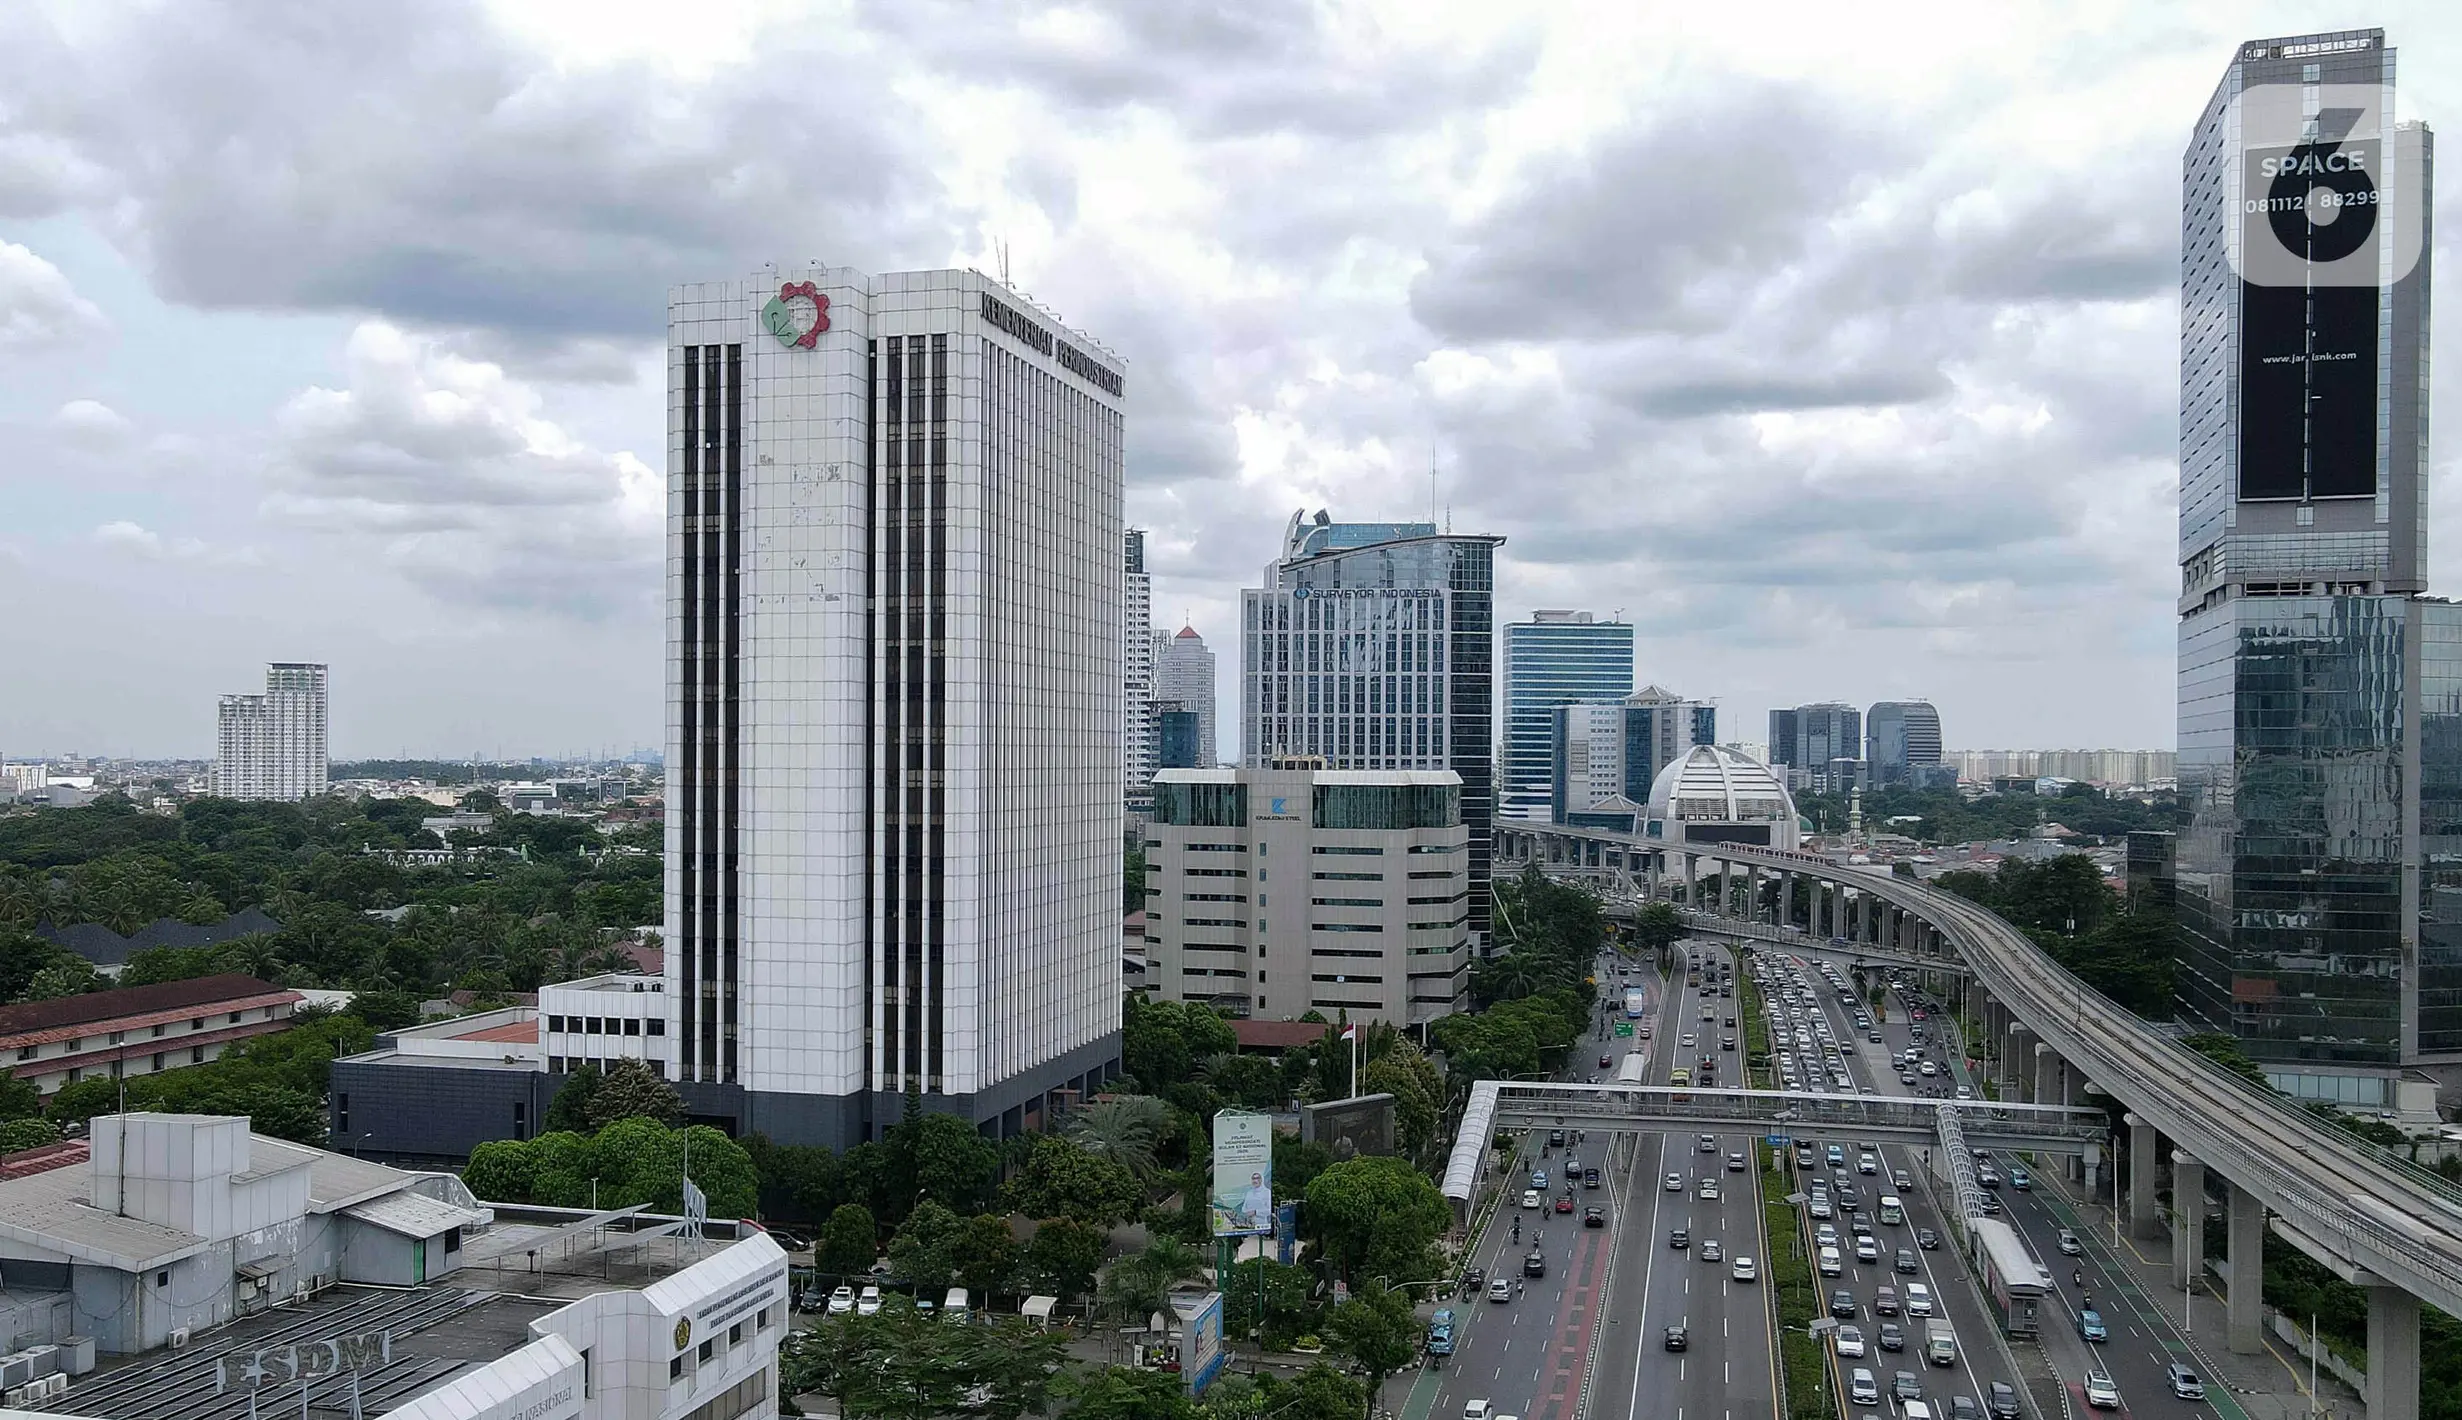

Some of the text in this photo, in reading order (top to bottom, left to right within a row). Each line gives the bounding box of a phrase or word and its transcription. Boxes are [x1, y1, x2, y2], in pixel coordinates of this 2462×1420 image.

[2260, 150, 2366, 178] SPACE
[981, 291, 1123, 398] KEMENTERIAN PERINDUSTRIAN
[1313, 588, 1442, 599] SURVEYOR INDONESIA
[224, 1334, 383, 1390] ESDM
